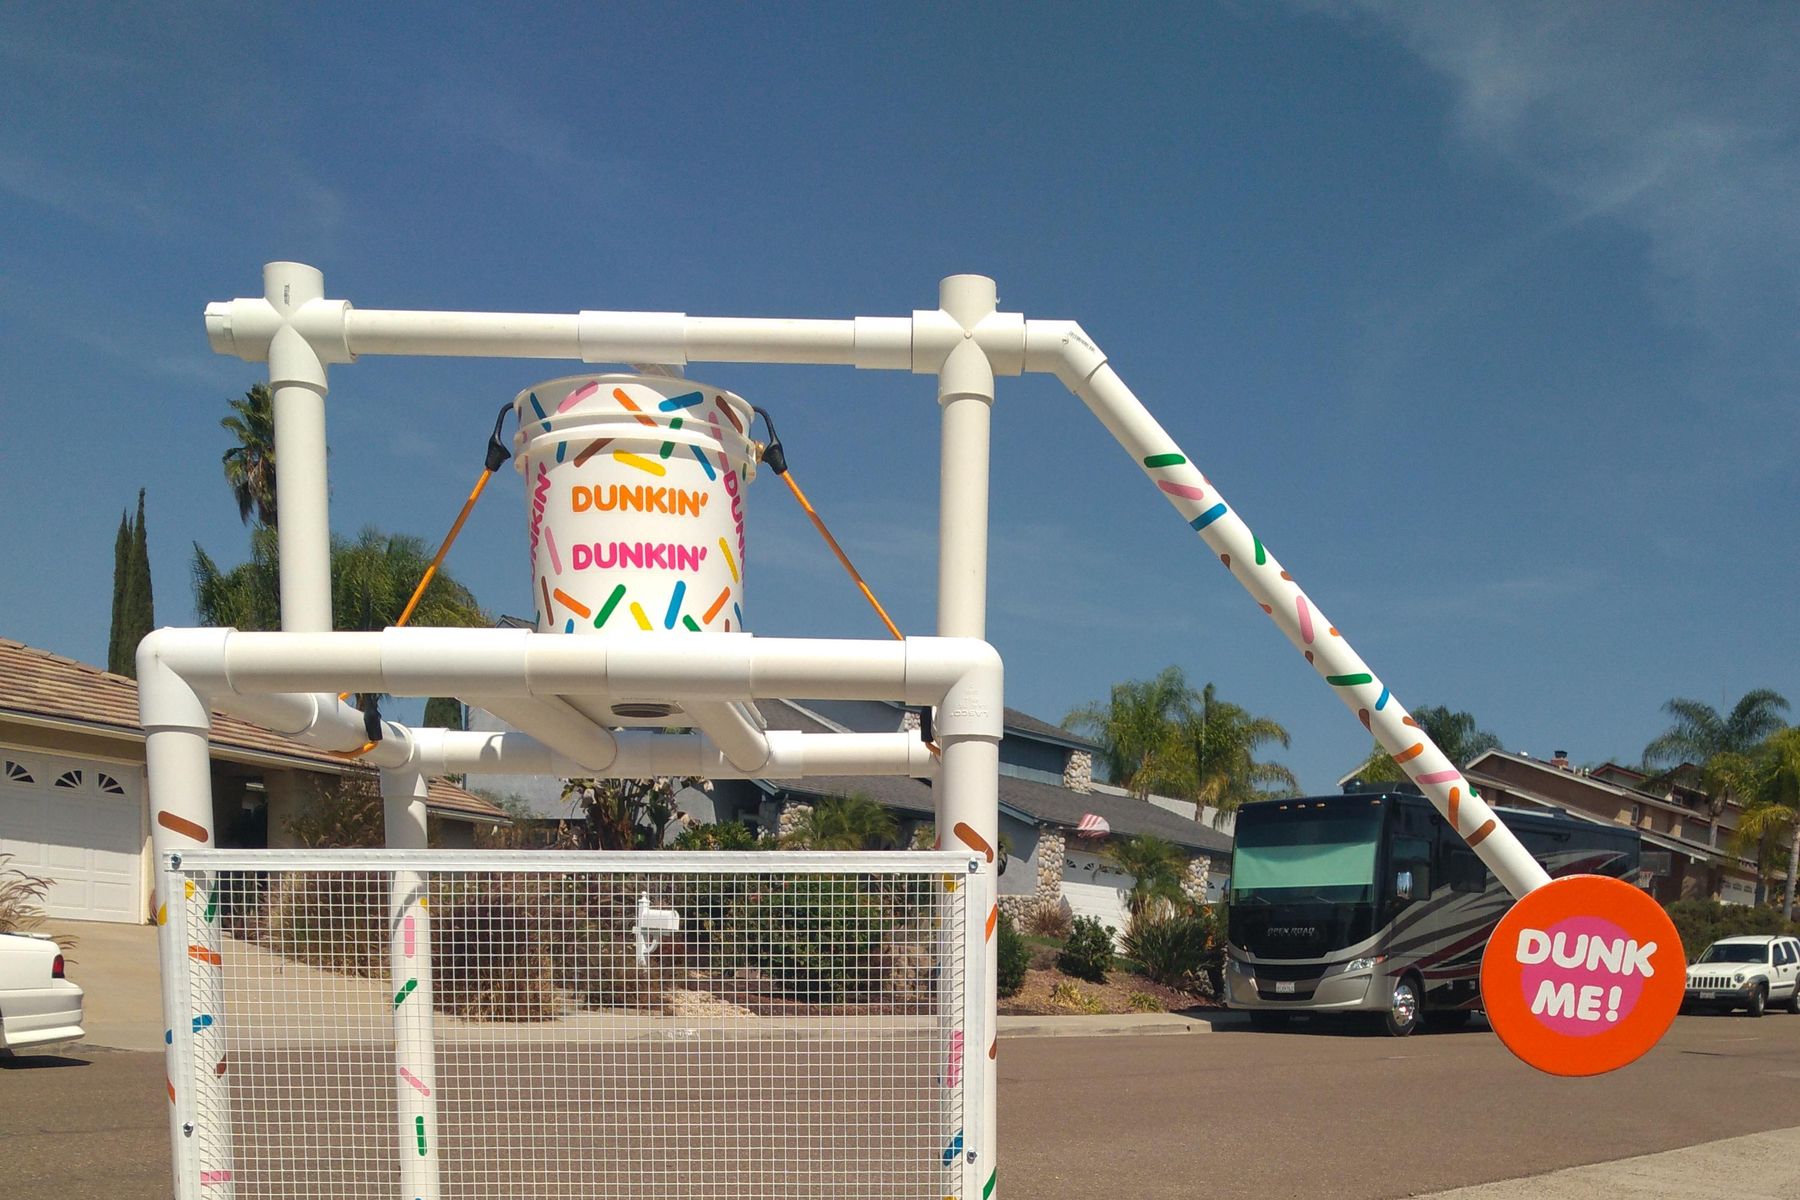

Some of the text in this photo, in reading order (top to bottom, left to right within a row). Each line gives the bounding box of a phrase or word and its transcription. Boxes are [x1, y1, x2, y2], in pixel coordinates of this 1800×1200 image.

[572, 484, 708, 517] DUNKIN'
[572, 542, 707, 572] DUNKIN'
[1291, 927, 1315, 936] ROAD
[1516, 928, 1657, 978] DUNK
[1531, 979, 1622, 1022] ME!
